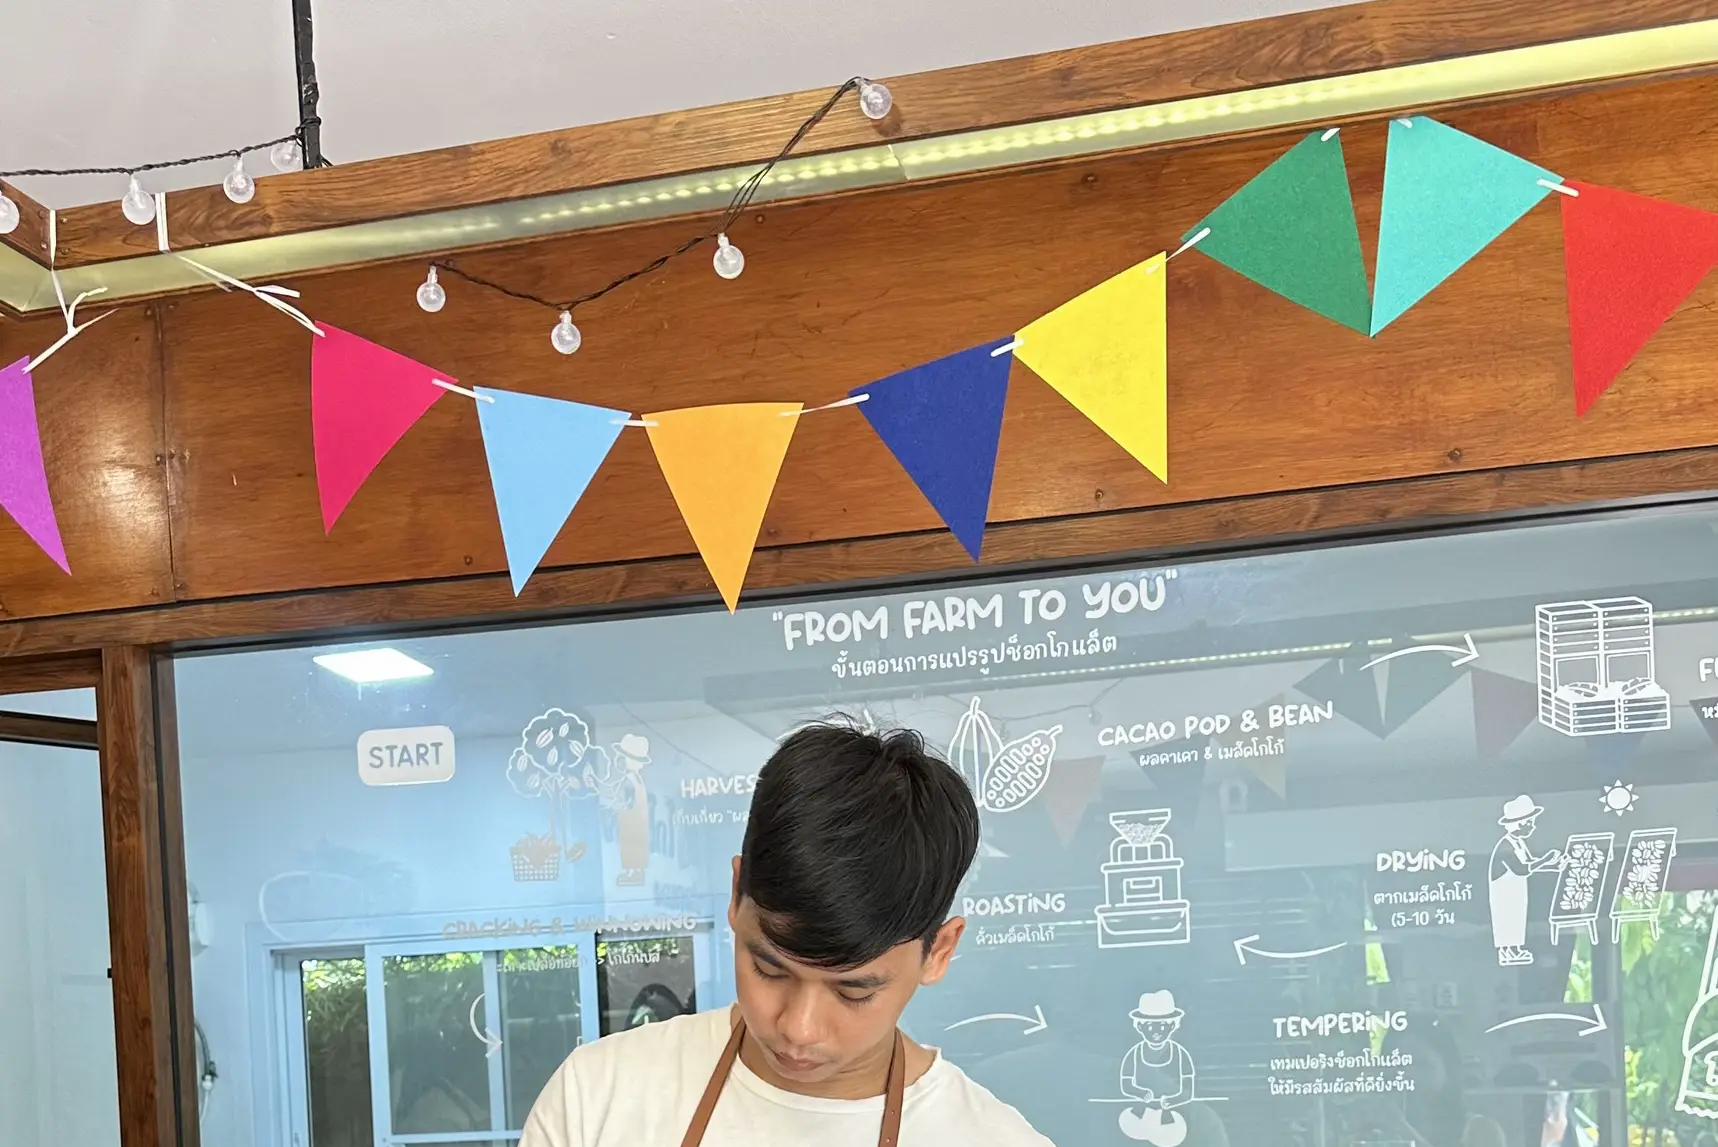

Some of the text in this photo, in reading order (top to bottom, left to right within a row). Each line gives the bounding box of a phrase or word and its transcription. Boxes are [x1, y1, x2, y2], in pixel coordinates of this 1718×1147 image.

[773, 569, 1178, 650] "FROM FARM TO YOU"
[1098, 700, 1333, 747] CACAO POD & BEAN
[368, 741, 444, 770] START
[1204, 746, 1213, 759] &
[681, 774, 759, 799] HARVES
